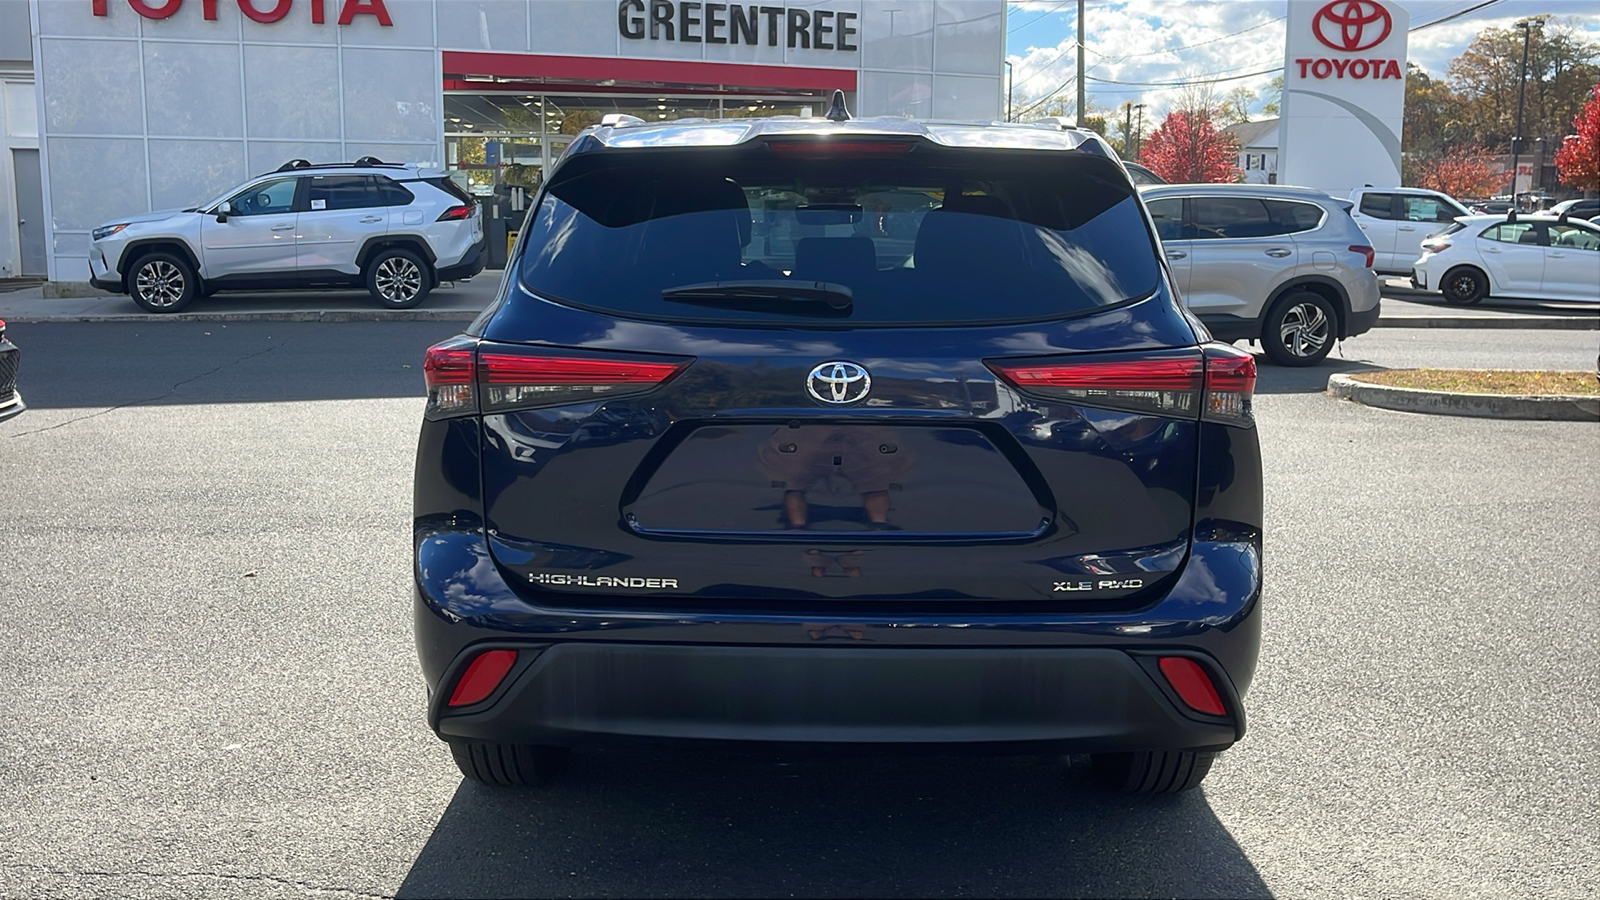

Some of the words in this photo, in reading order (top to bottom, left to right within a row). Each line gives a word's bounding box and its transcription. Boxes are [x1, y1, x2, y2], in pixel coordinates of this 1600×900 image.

[618, 0, 857, 51] GREENTREE
[1295, 58, 1402, 80] TOYOTA
[528, 572, 679, 588] HIGHLANDER
[1053, 581, 1092, 592] XLE
[1098, 579, 1143, 590] AWD
